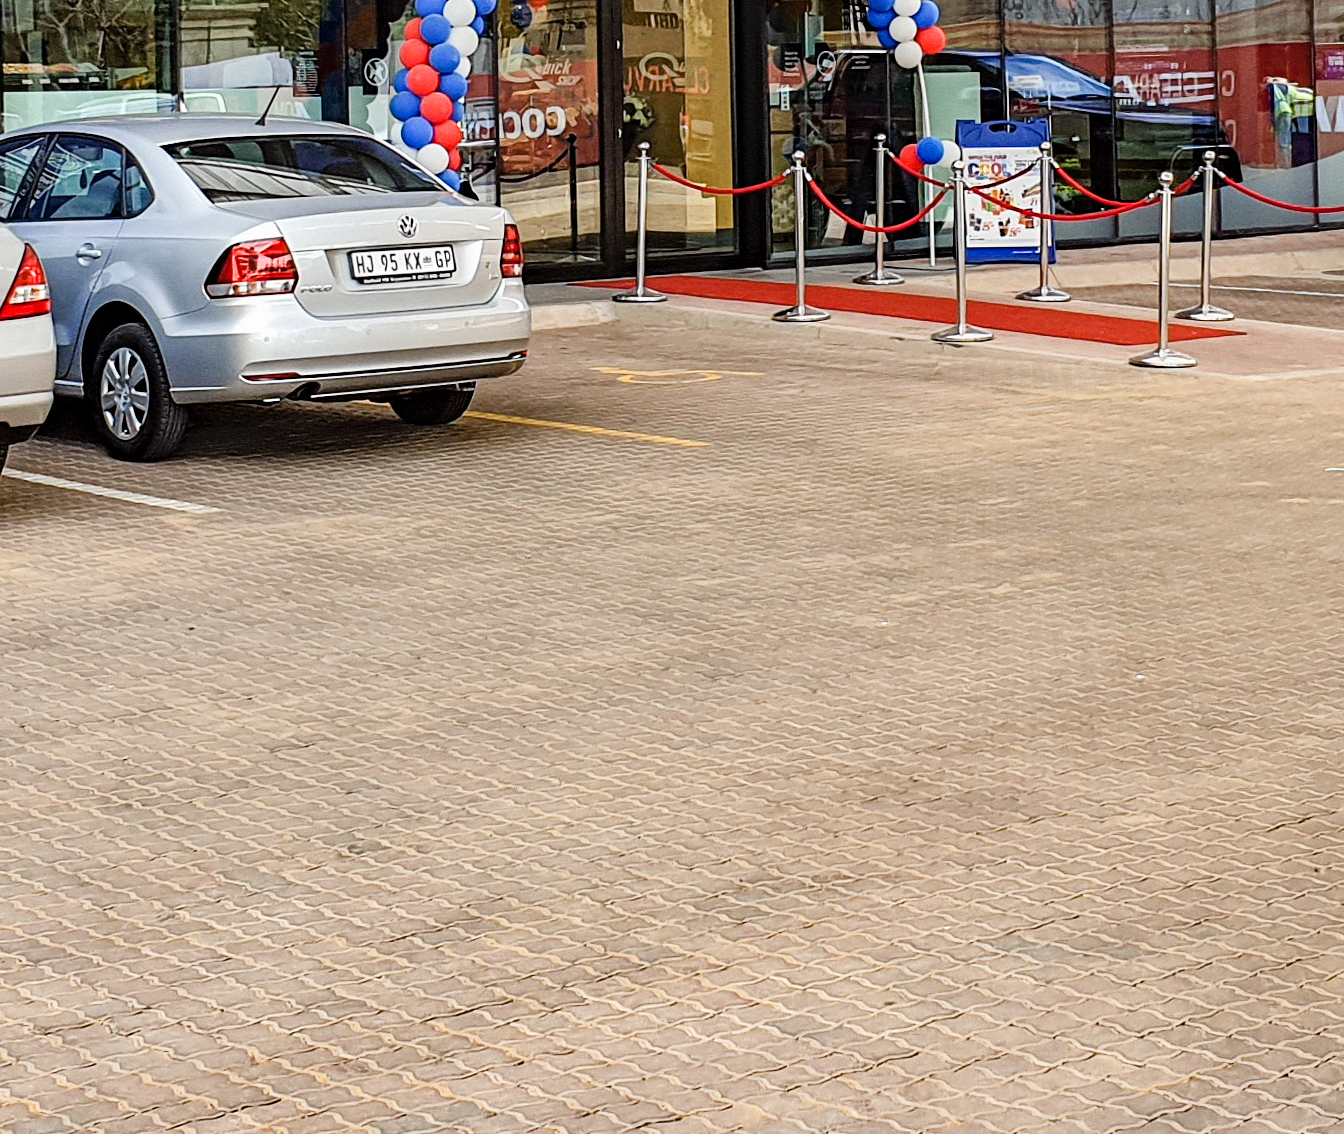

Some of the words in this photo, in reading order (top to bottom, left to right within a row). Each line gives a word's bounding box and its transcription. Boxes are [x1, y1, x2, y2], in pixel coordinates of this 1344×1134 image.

[381, 253, 399, 272] 95
[405, 250, 422, 271] KX
[435, 248, 452, 269] GP
